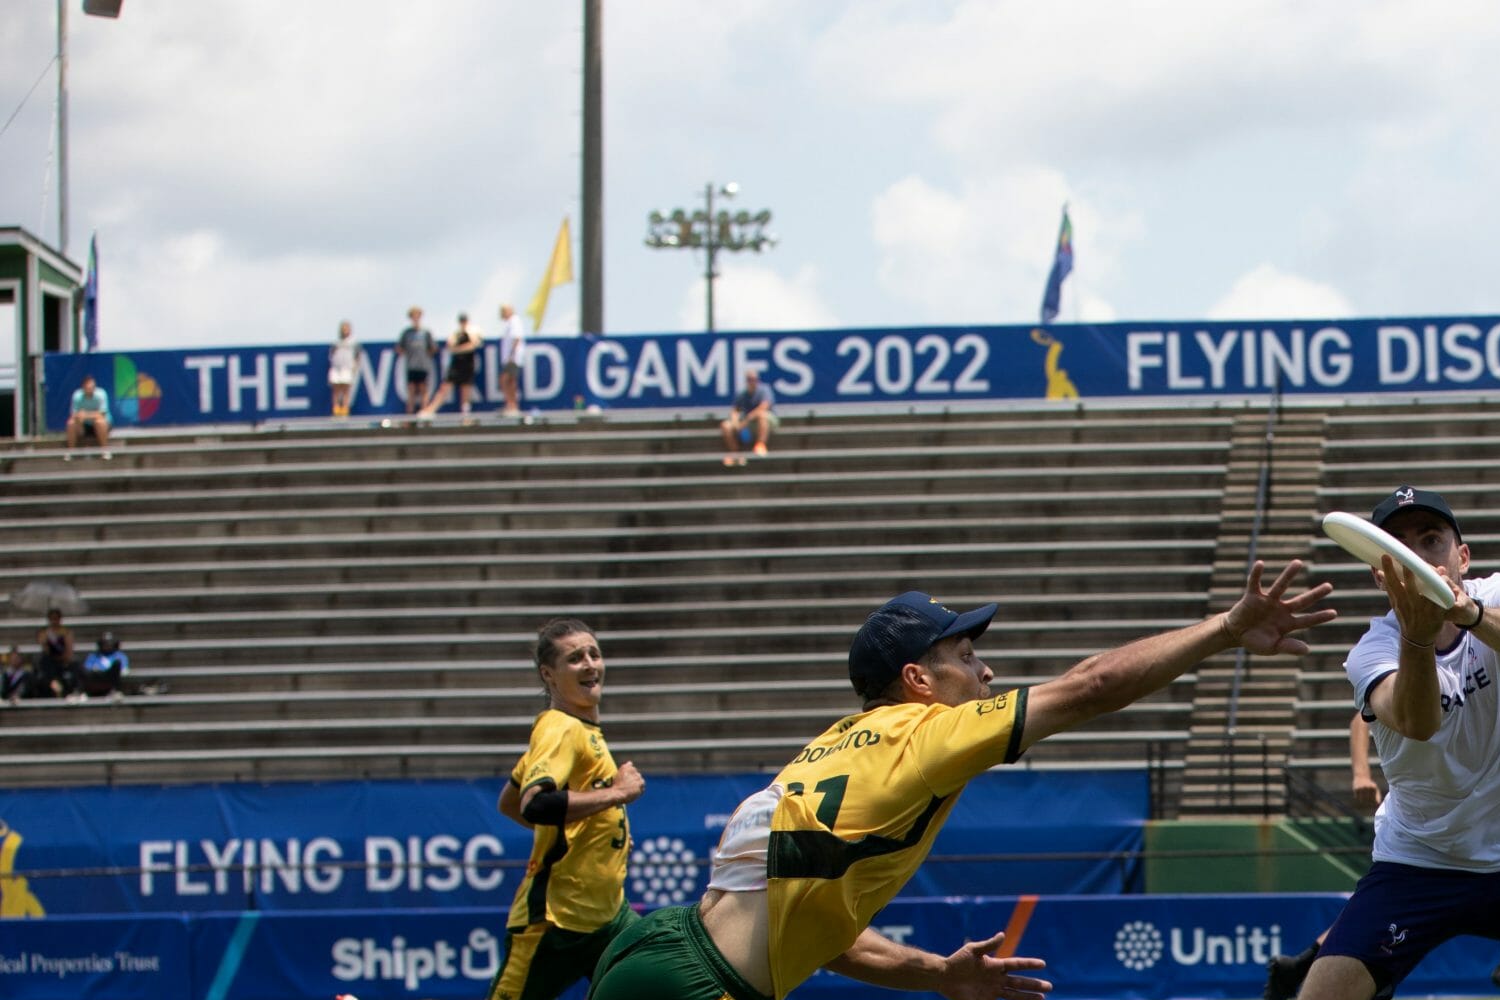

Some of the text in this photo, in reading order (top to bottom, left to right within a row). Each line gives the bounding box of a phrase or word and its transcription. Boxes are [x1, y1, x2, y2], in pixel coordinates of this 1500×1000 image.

[185, 354, 310, 414] THE
[586, 337, 814, 400] GAMES
[836, 333, 990, 395] 2022
[1126, 327, 1353, 391] FLYING
[1440, 667, 1491, 713] RACE
[140, 834, 503, 895] FLYING DISC
[31, 952, 113, 979] Properties
[114, 951, 159, 972] Trust
[332, 936, 456, 990] Shipt
[1171, 924, 1281, 965] Uniti
